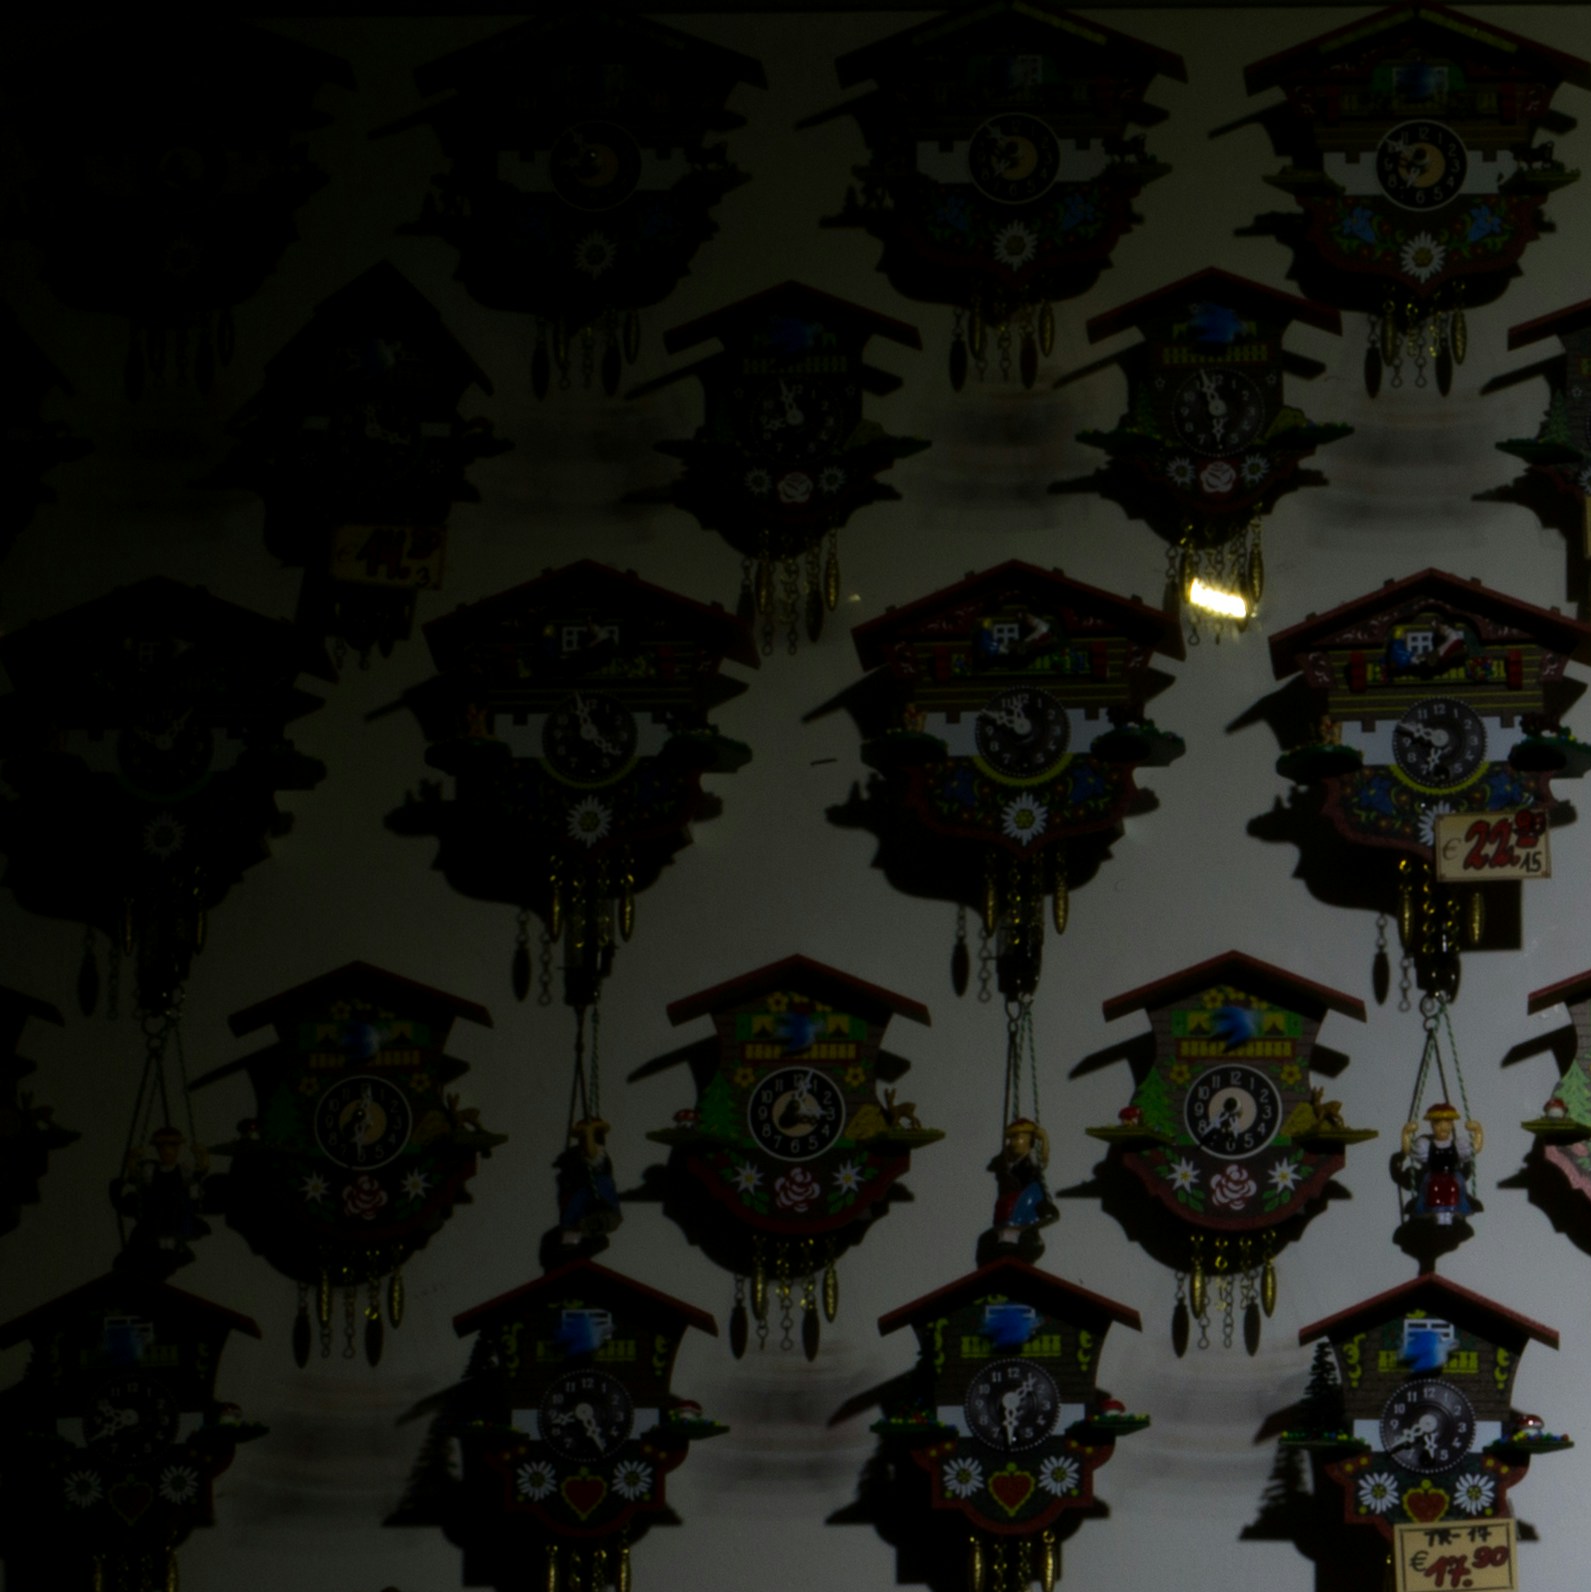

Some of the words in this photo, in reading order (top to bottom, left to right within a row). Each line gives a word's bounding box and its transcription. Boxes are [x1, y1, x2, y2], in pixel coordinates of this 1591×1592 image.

[1443, 838, 1460, 859] €
[1520, 853, 1541, 872] 15
[1410, 1551, 1429, 1572] €
